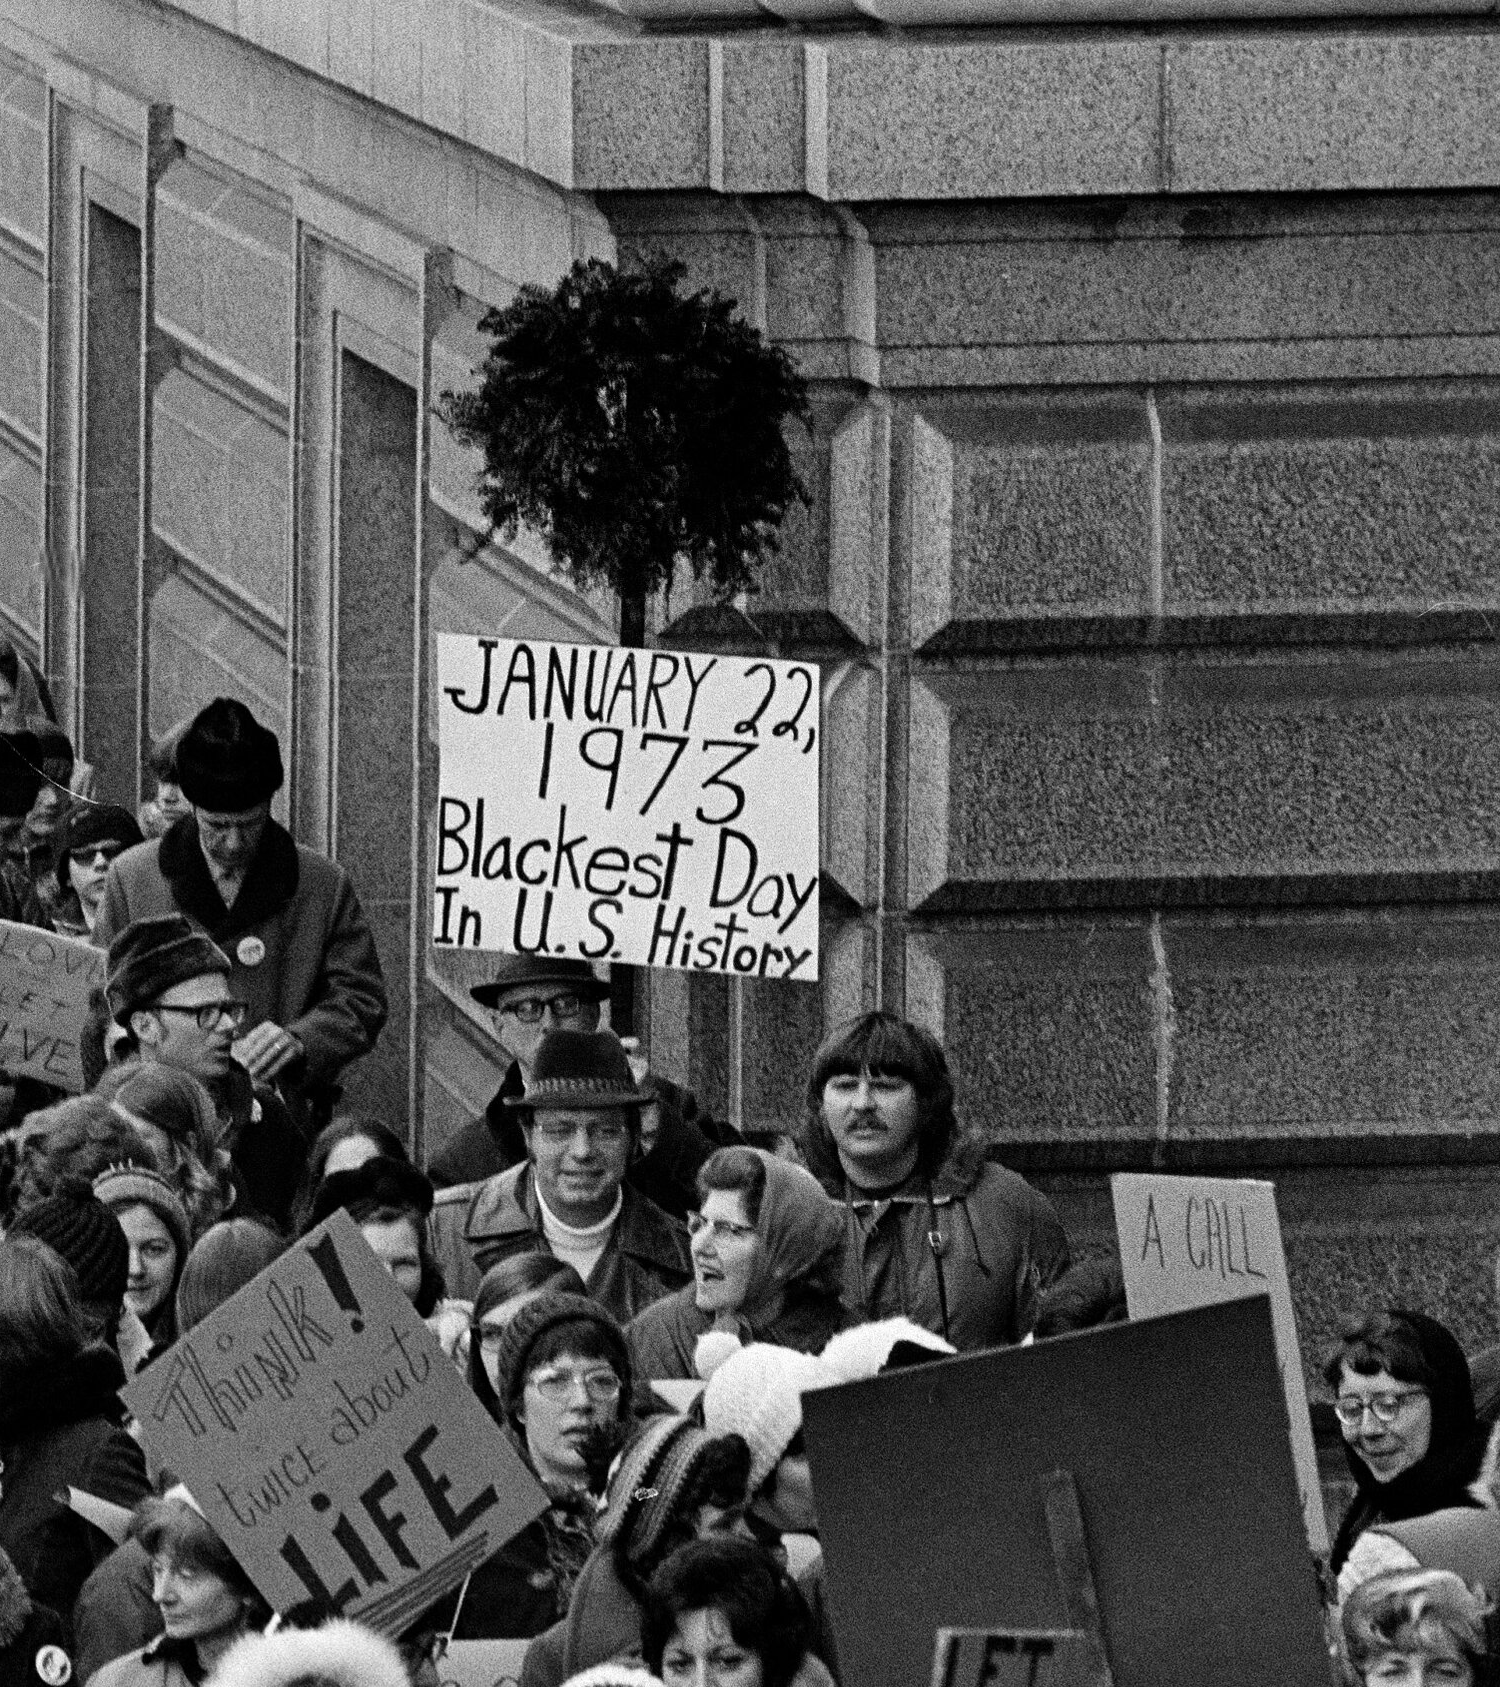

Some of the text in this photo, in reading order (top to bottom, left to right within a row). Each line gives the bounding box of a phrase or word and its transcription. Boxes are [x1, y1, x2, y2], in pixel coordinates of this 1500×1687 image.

[443, 638, 816, 754] JANUARY 22,
[537, 722, 760, 826] 1973
[437, 796, 819, 935] Blackest Day
[433, 886, 813, 979] In U.S. History
[1140, 1192, 1269, 1280] A CALL
[216, 1325, 431, 1529] twice about
